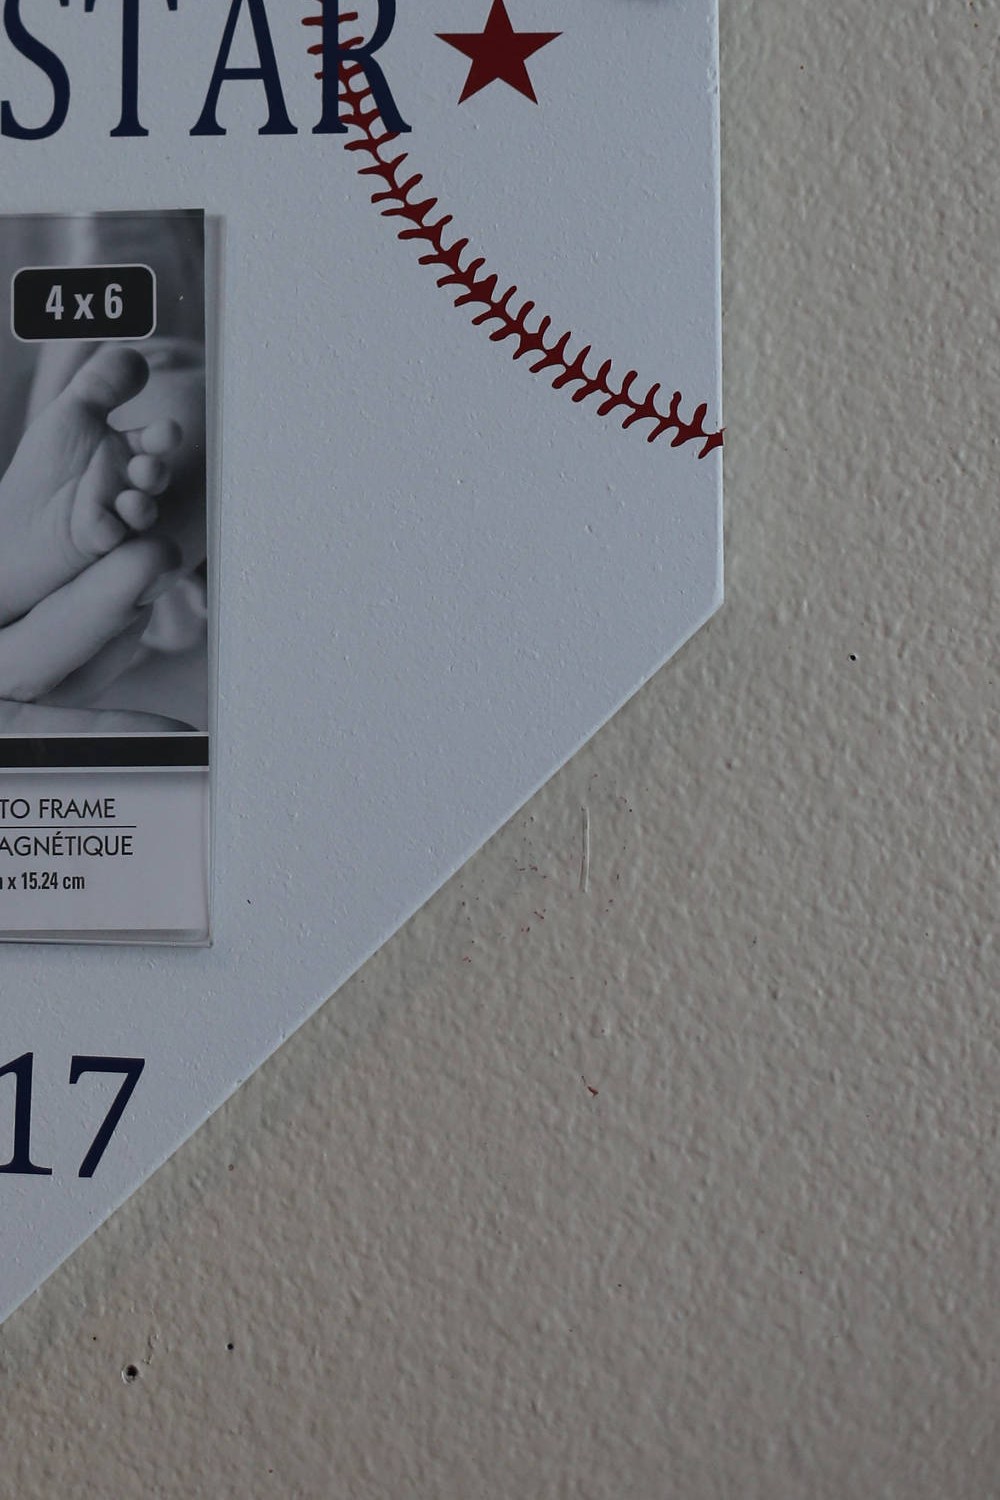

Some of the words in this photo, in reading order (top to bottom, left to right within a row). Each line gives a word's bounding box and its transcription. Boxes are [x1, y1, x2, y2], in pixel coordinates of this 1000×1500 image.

[45, 285, 65, 320] 4
[73, 293, 95, 320] x
[104, 283, 123, 319] 6
[39, 798, 116, 819] FRAME
[7, 876, 17, 890] x
[21, 871, 59, 890] 15.24
[62, 876, 85, 890] cm
